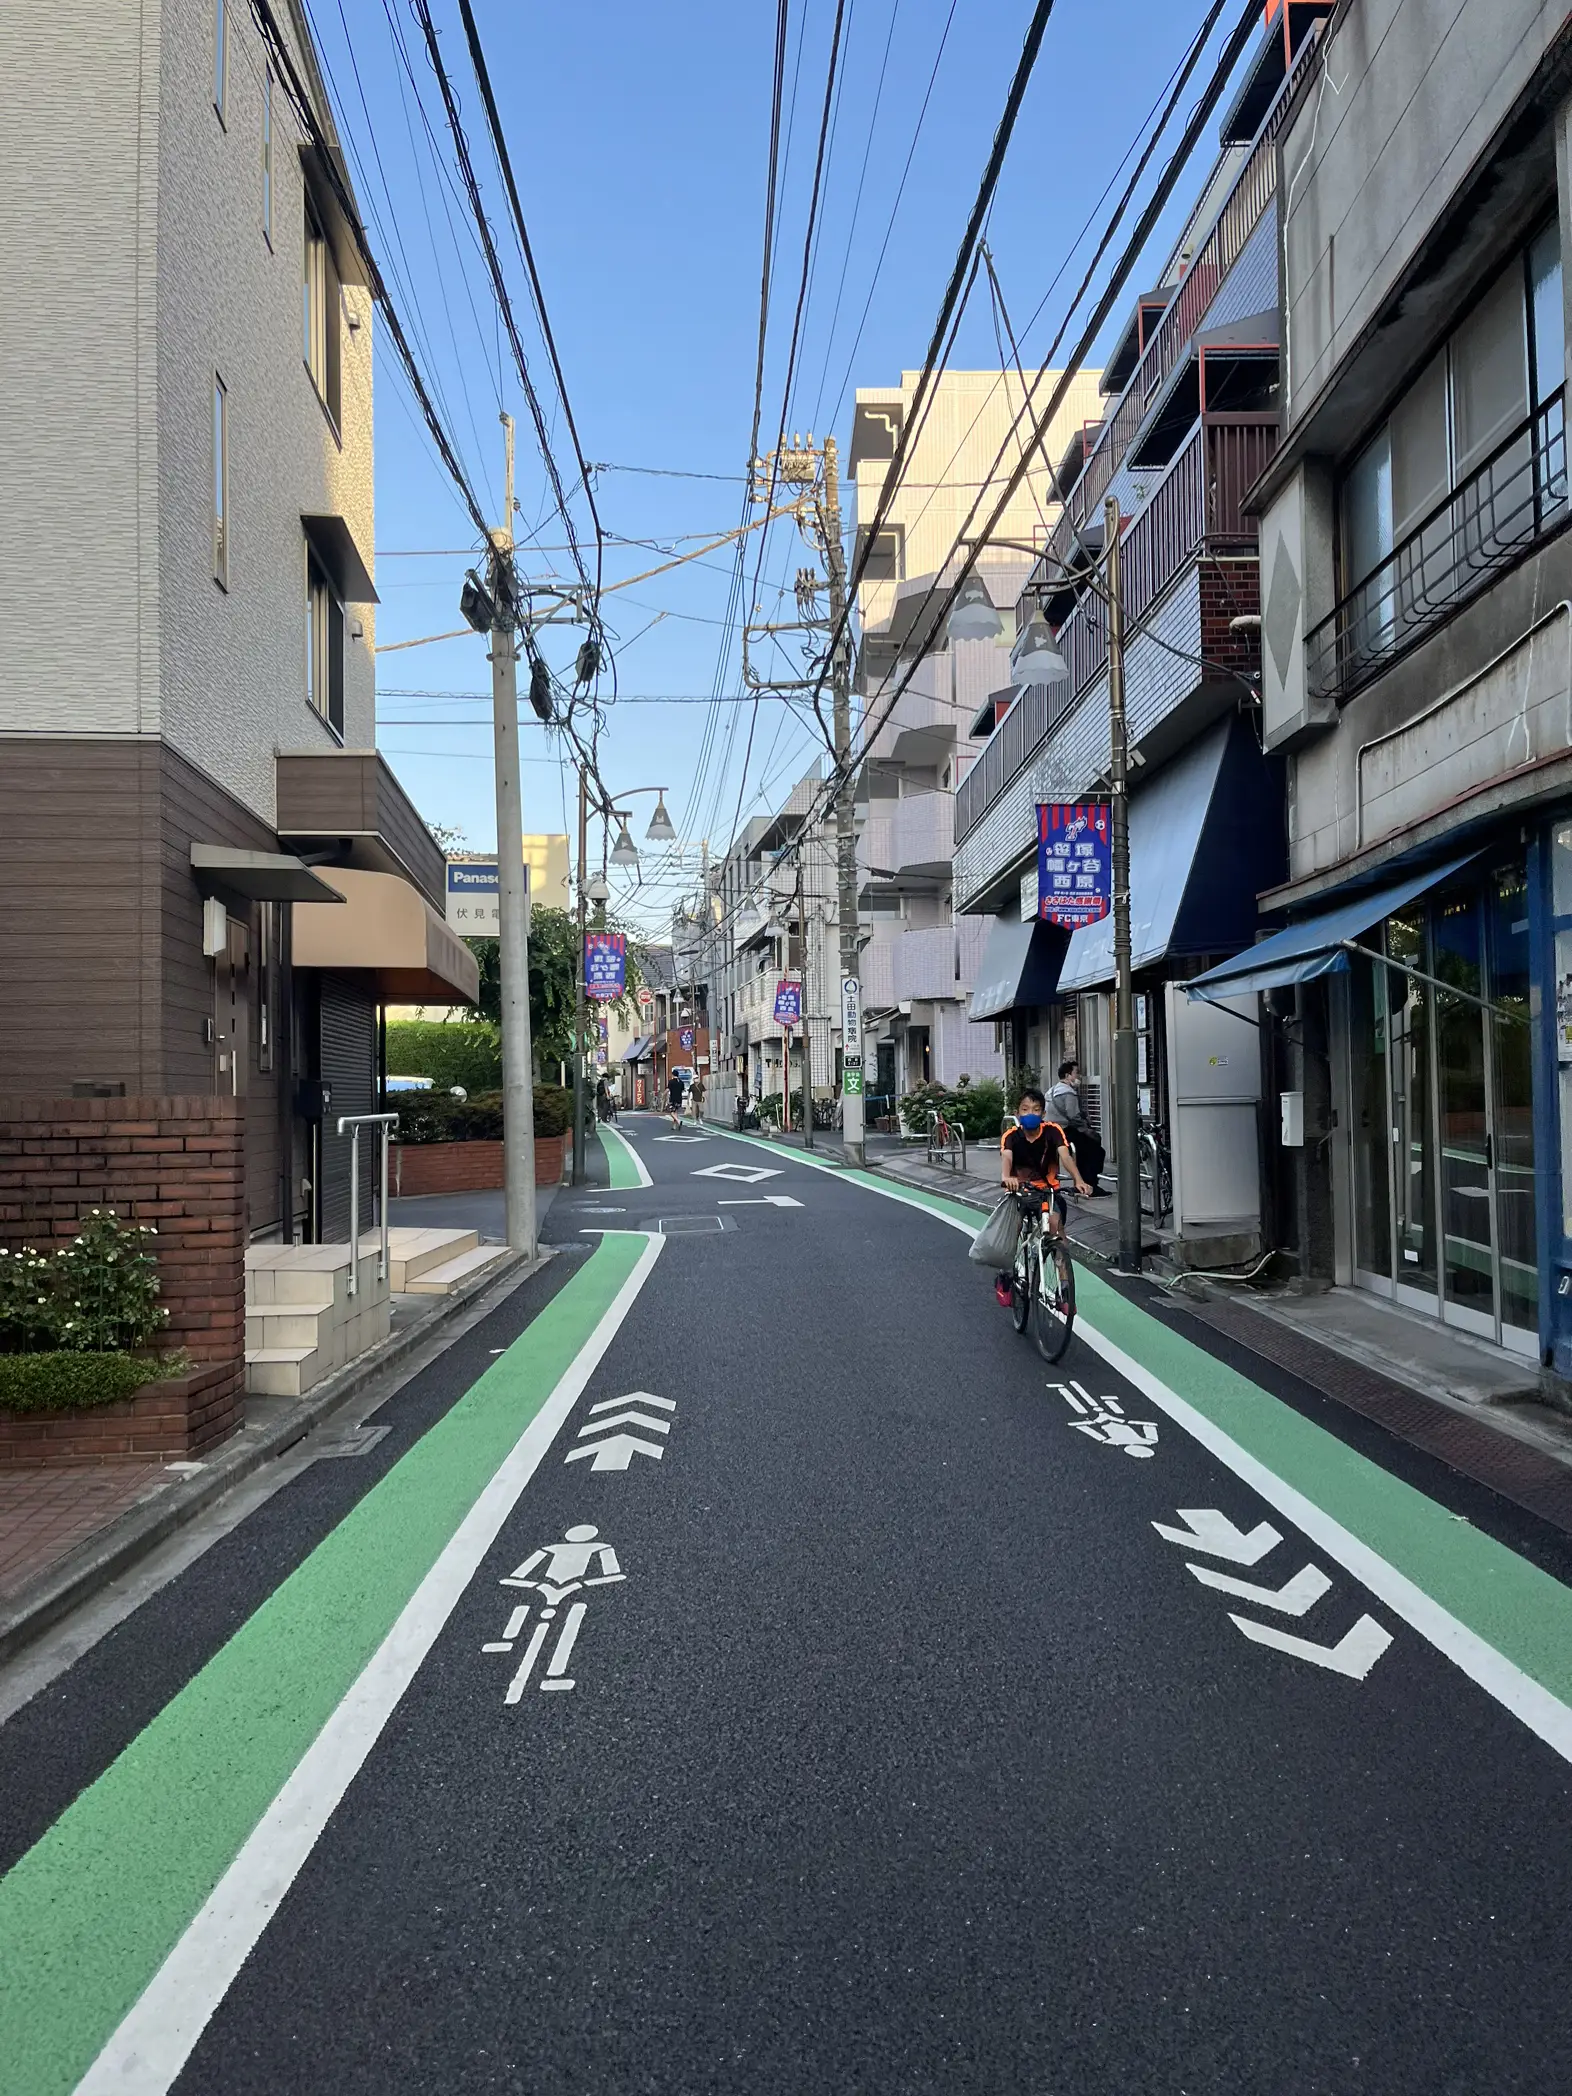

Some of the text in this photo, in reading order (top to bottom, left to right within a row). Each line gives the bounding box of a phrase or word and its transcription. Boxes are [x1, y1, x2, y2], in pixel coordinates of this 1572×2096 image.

[1053, 842, 1095, 857] 笹塚
[1053, 874, 1094, 888] 西原
[847, 995, 857, 1043] 土田動物病院
[847, 1077, 860, 1090] 文
